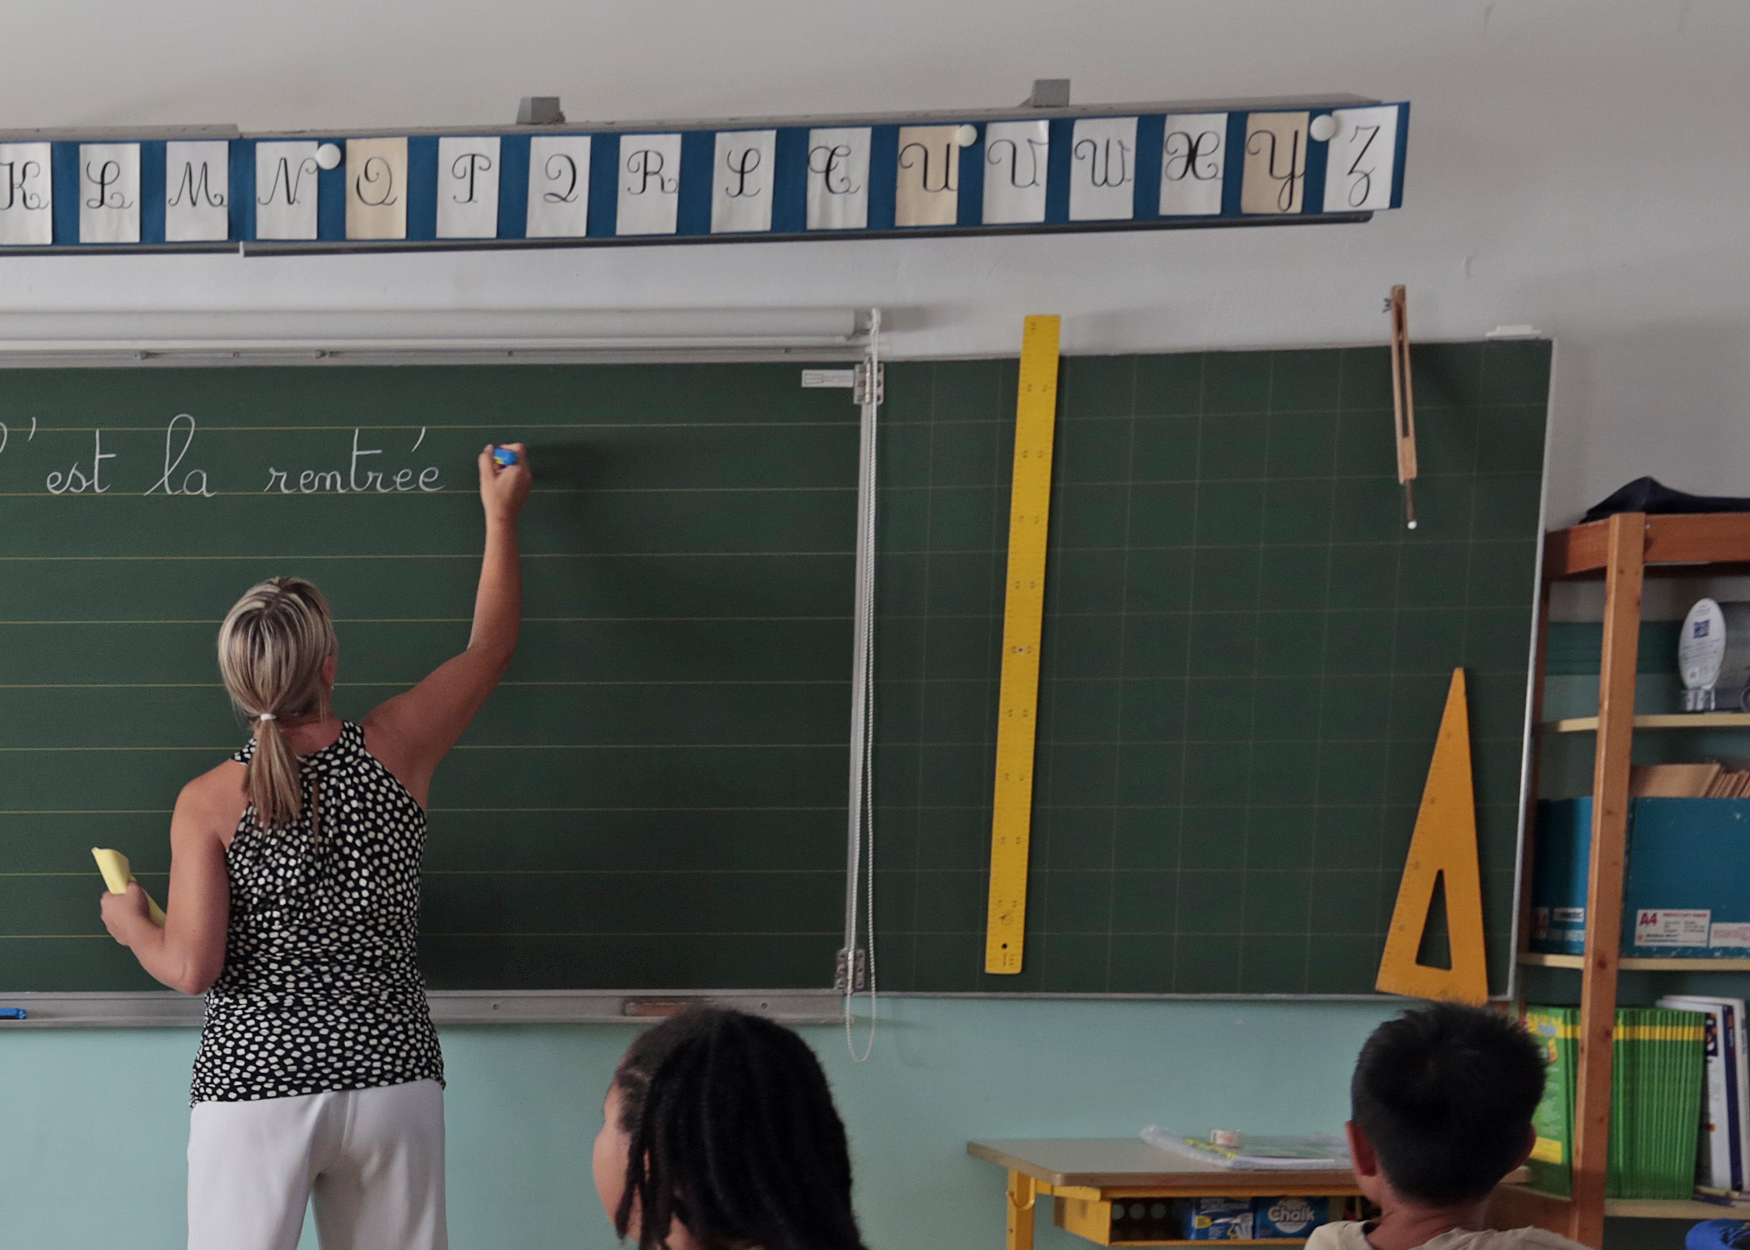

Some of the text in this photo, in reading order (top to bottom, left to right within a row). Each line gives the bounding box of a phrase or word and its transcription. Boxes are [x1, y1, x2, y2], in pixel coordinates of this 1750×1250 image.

[86, 160, 133, 209] L
[168, 161, 228, 207] M
[258, 157, 319, 205] N
[355, 157, 398, 207] O
[451, 153, 492, 204] P
[543, 153, 579, 204] Q
[627, 150, 680, 195] R
[725, 147, 762, 198] S
[807, 145, 860, 195] T
[899, 142, 958, 193] U
[987, 138, 1049, 188] V
[1075, 137, 1131, 188] W
[1165, 130, 1222, 181] X
[1246, 128, 1305, 212] Y
[1347, 125, 1381, 207] Z
[144, 413, 218, 497] la
[263, 426, 446, 493] rentrée
[1267, 1205, 1315, 1223] Chalk
